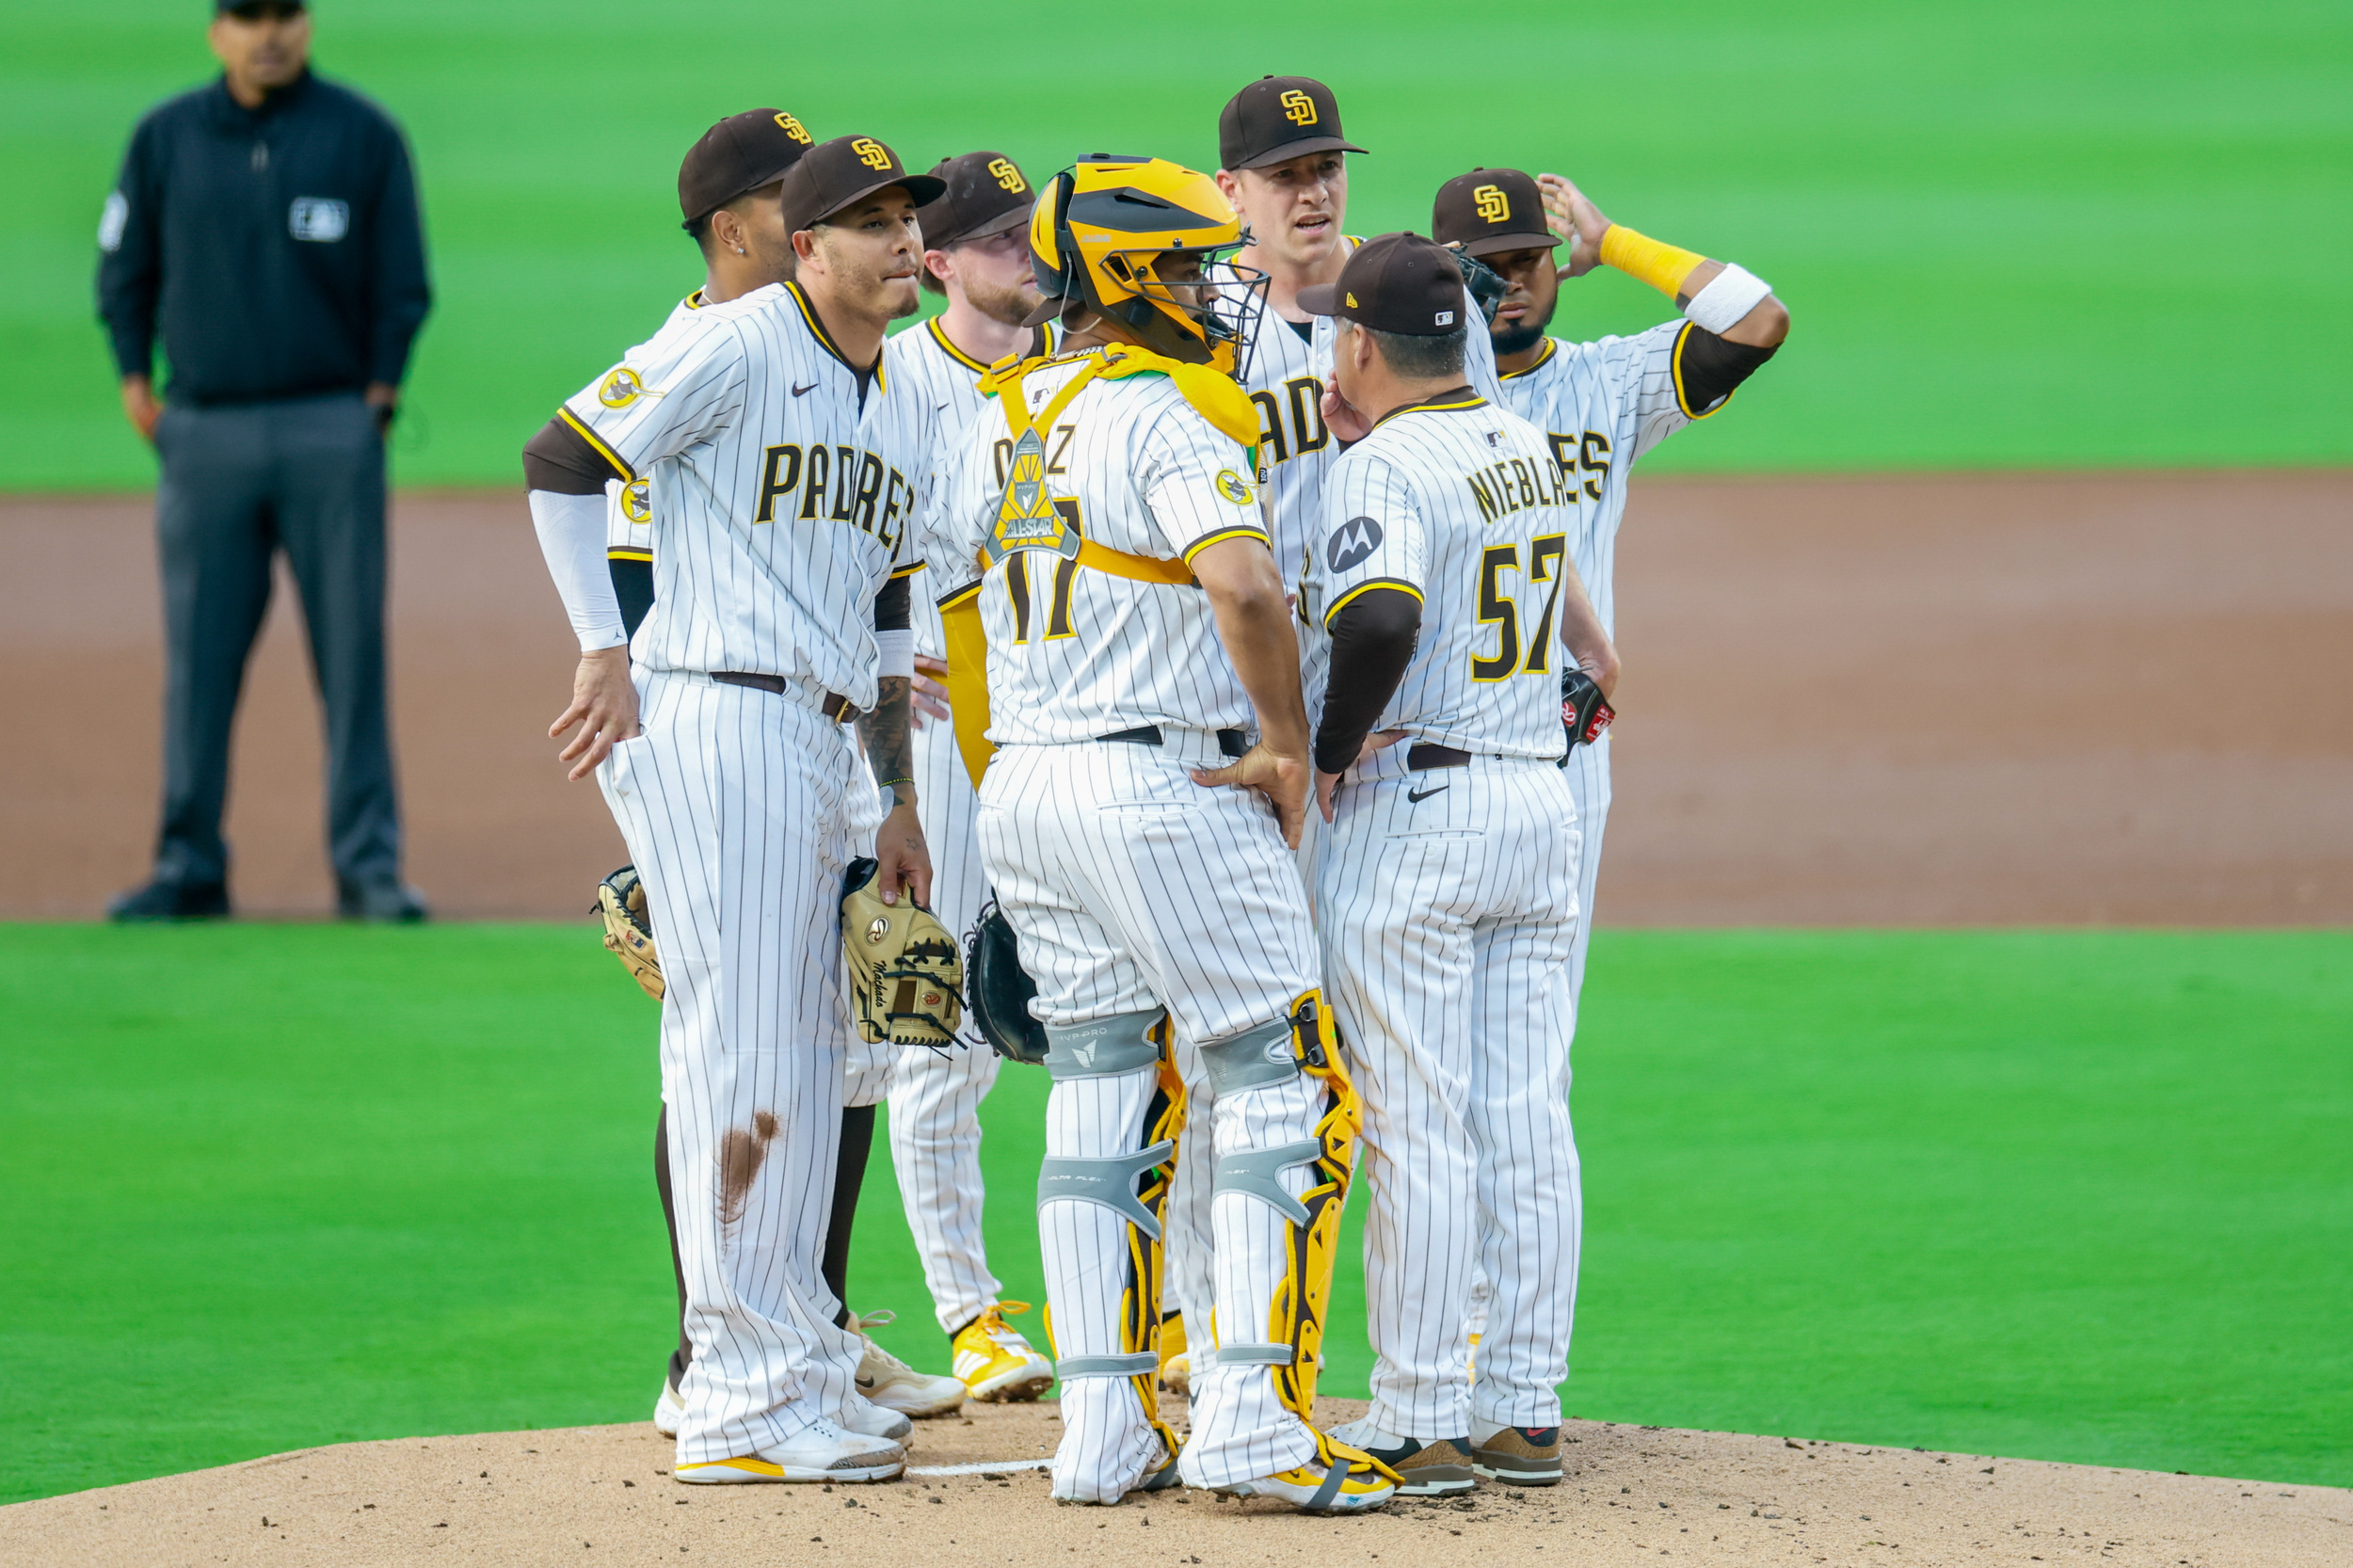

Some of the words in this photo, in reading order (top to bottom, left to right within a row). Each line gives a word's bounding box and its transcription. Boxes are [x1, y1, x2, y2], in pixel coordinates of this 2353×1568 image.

[1280, 89, 1318, 126] SD
[774, 112, 812, 145] SD
[851, 137, 892, 170] SD
[988, 157, 1026, 194] SD
[1473, 184, 1511, 223] SD
[1466, 456, 1567, 524] NIEBLA
[1003, 517, 1053, 538] ALL-STAR
[1470, 532, 1566, 682] 57
[873, 960, 888, 1008] Machado
